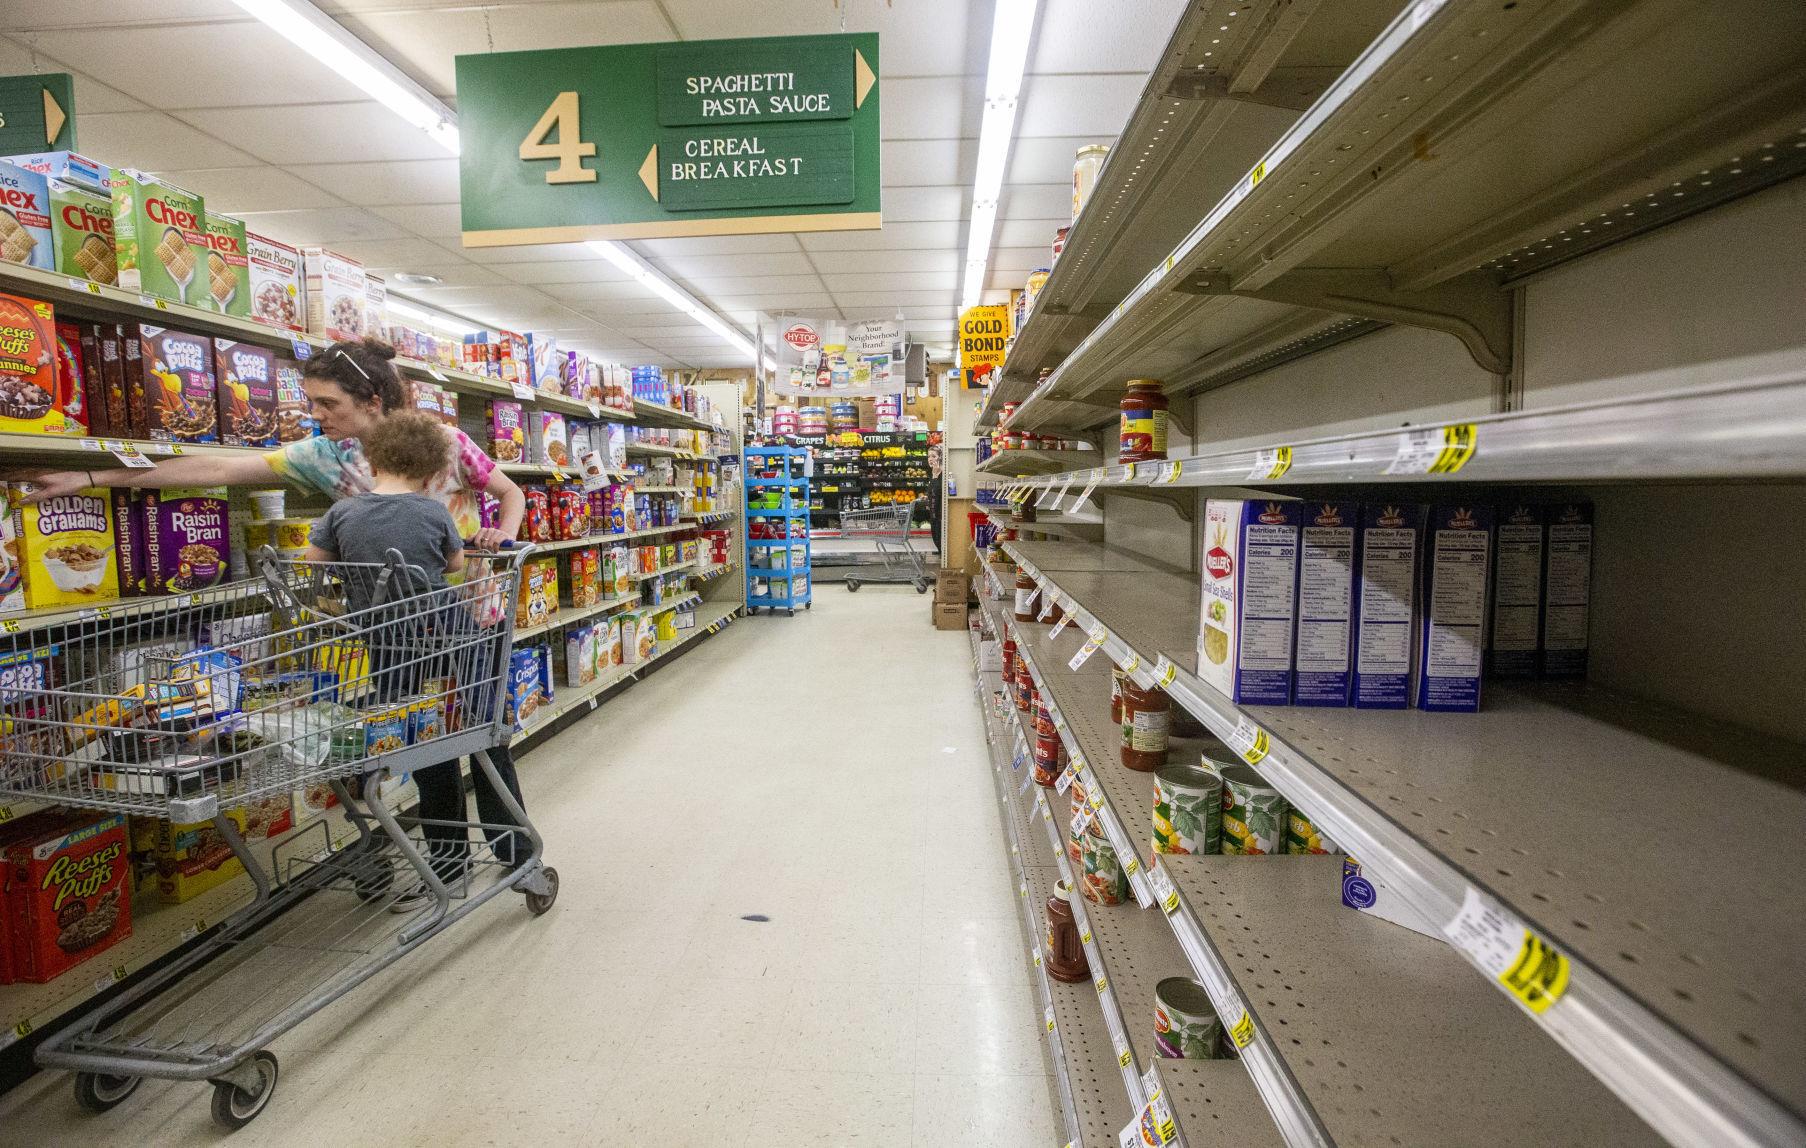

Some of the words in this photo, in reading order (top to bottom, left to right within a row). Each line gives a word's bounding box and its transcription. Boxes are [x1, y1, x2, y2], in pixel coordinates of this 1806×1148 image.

[686, 72, 795, 95] SPAGHETTI
[701, 97, 761, 117] PASTA
[769, 94, 831, 113] SAUCE
[519, 91, 598, 184] 4
[685, 137, 765, 157] CEREAL
[671, 158, 803, 181] BREAKFAST
[0, 177, 18, 188] ice
[62, 204, 113, 235] Che
[145, 197, 201, 232] Chex
[246, 242, 272, 262] Grain
[274, 250, 297, 269] Berry
[0, 326, 36, 341] eese's
[848, 330, 899, 342] Neighborhood
[964, 319, 1002, 334] GOLD
[964, 337, 1005, 352] BOND
[970, 353, 1000, 362] STAMPS
[796, 437, 824, 445] GRAPES
[863, 435, 891, 443] CITRUS
[171, 512, 221, 532] Raisin
[187, 527, 222, 544] Bran
[1398, 551, 1412, 559] 200
[42, 842, 122, 890] Reese's
[54, 864, 114, 911] Puffs
